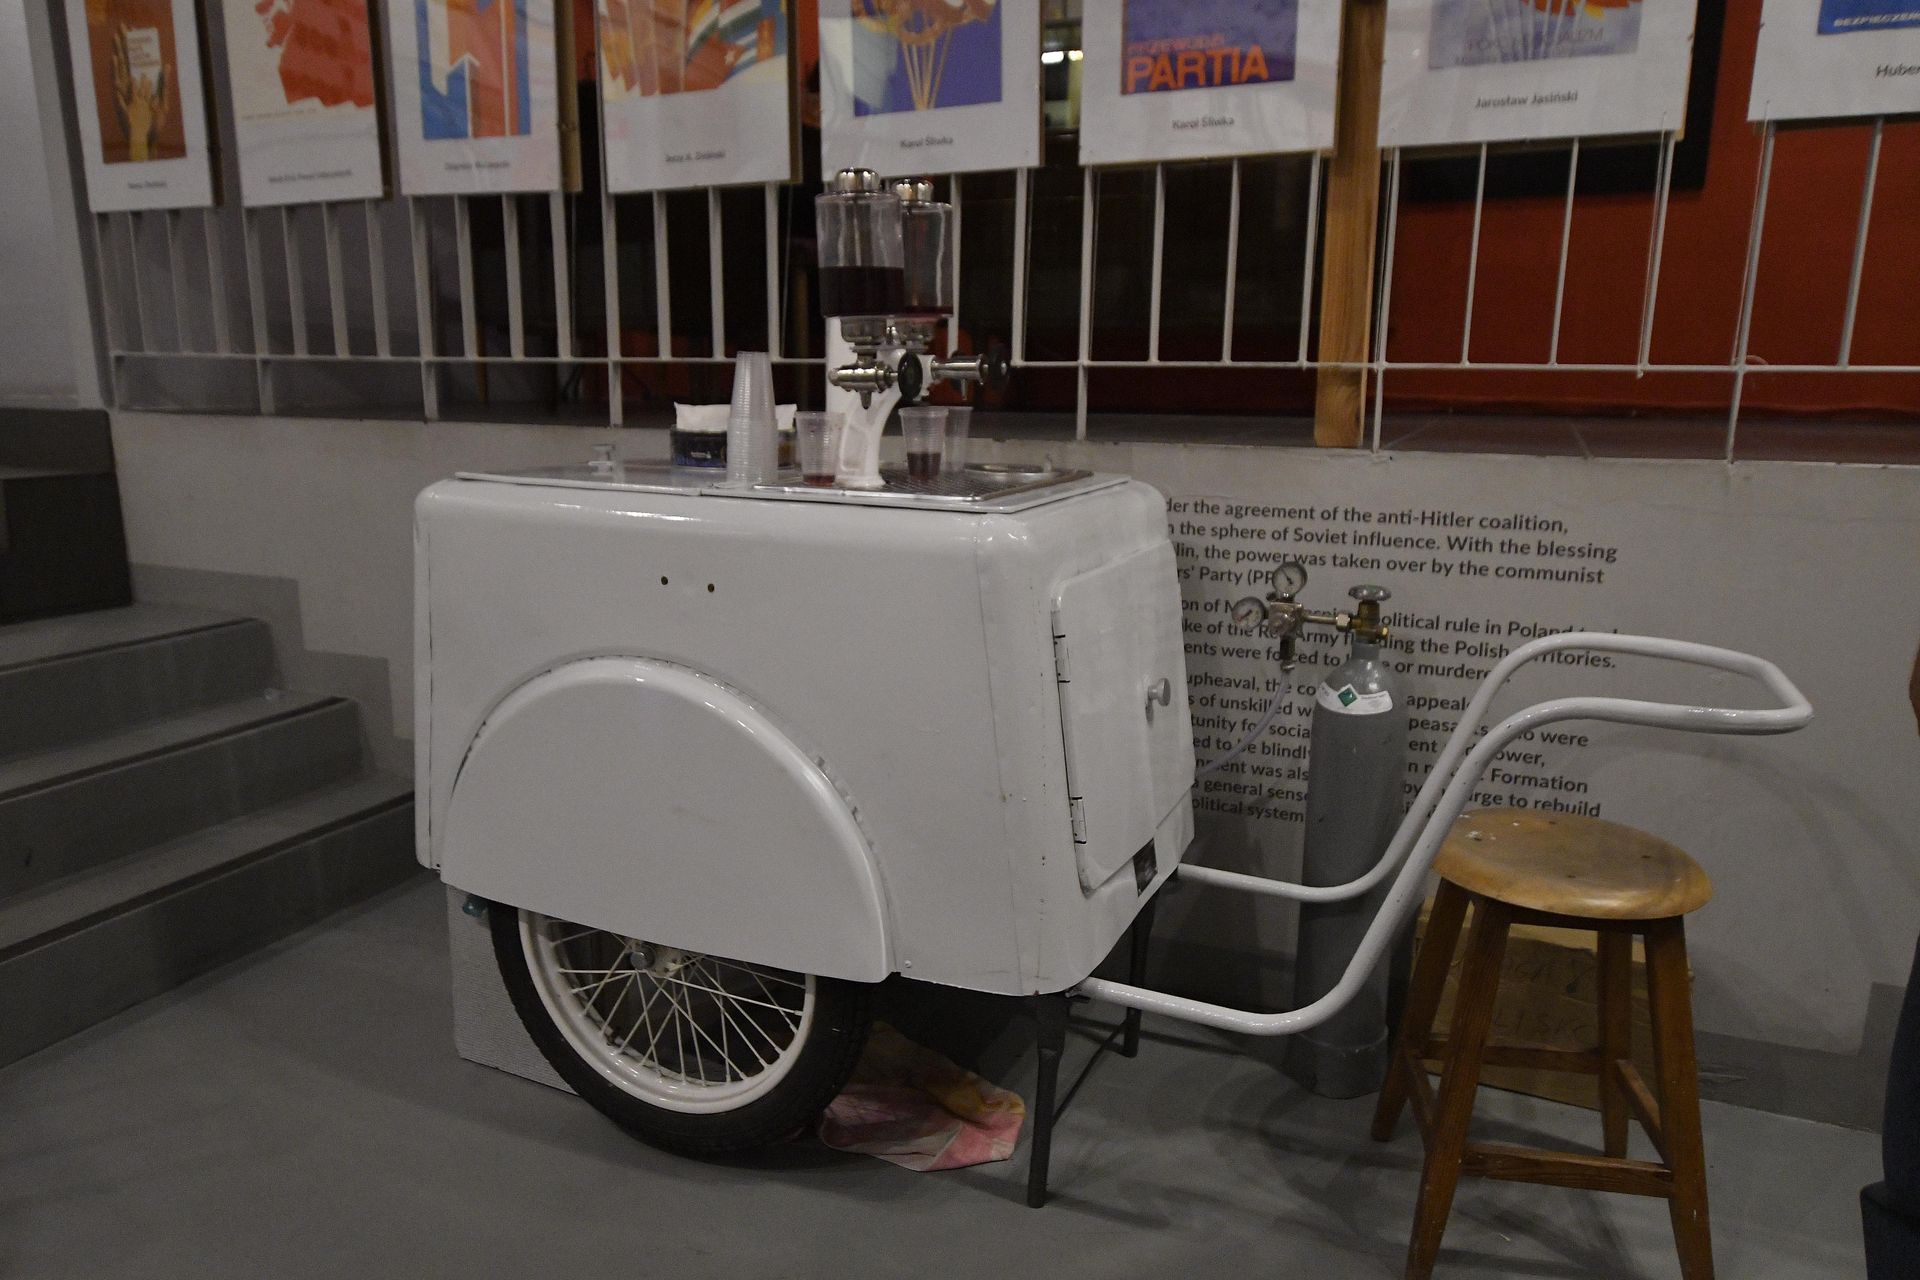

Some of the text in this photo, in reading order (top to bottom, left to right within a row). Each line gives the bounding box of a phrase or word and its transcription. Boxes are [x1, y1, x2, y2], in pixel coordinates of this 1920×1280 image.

[1127, 44, 1269, 93] PARTIA
[1194, 500, 1220, 515] the
[1225, 504, 1316, 520] agreement
[1321, 506, 1339, 521] of
[1344, 507, 1372, 522] the
[1378, 510, 1474, 528] anti-Hitler
[1479, 514, 1568, 534] coalition,
[1180, 521, 1206, 536] the
[1211, 524, 1266, 540] sphere
[1272, 527, 1289, 541] of
[1294, 527, 1347, 544] Soviet
[1353, 530, 1440, 550] influence.
[1447, 535, 1493, 553] With
[1500, 538, 1531, 555] the
[1537, 540, 1618, 563] blessing
[1175, 543, 1604, 584] lin, the power was taken over by the communist
[1200, 566, 1243, 585] Party
[1204, 600, 1220, 613] of
[1379, 612, 1440, 631] olitical
[1445, 617, 1480, 633] rule
[1485, 619, 1501, 634] in
[1207, 622, 1225, 635] of
[1420, 638, 1449, 654] the
[1455, 641, 1510, 659] Polish
[1221, 646, 1261, 659] were
[1267, 647, 1318, 664] foced
[1324, 653, 1340, 667] to
[1395, 661, 1414, 673] or
[1200, 694, 1216, 707] of
[1541, 731, 1589, 747] were
[1216, 738, 1232, 751] to
[1262, 742, 1312, 759] blindl
[1491, 768, 1588, 794] Formation
[1204, 780, 1263, 796] general
[1251, 764, 1283, 778] was
[1509, 794, 1528, 808] to
[1534, 798, 1601, 818] rebuild
